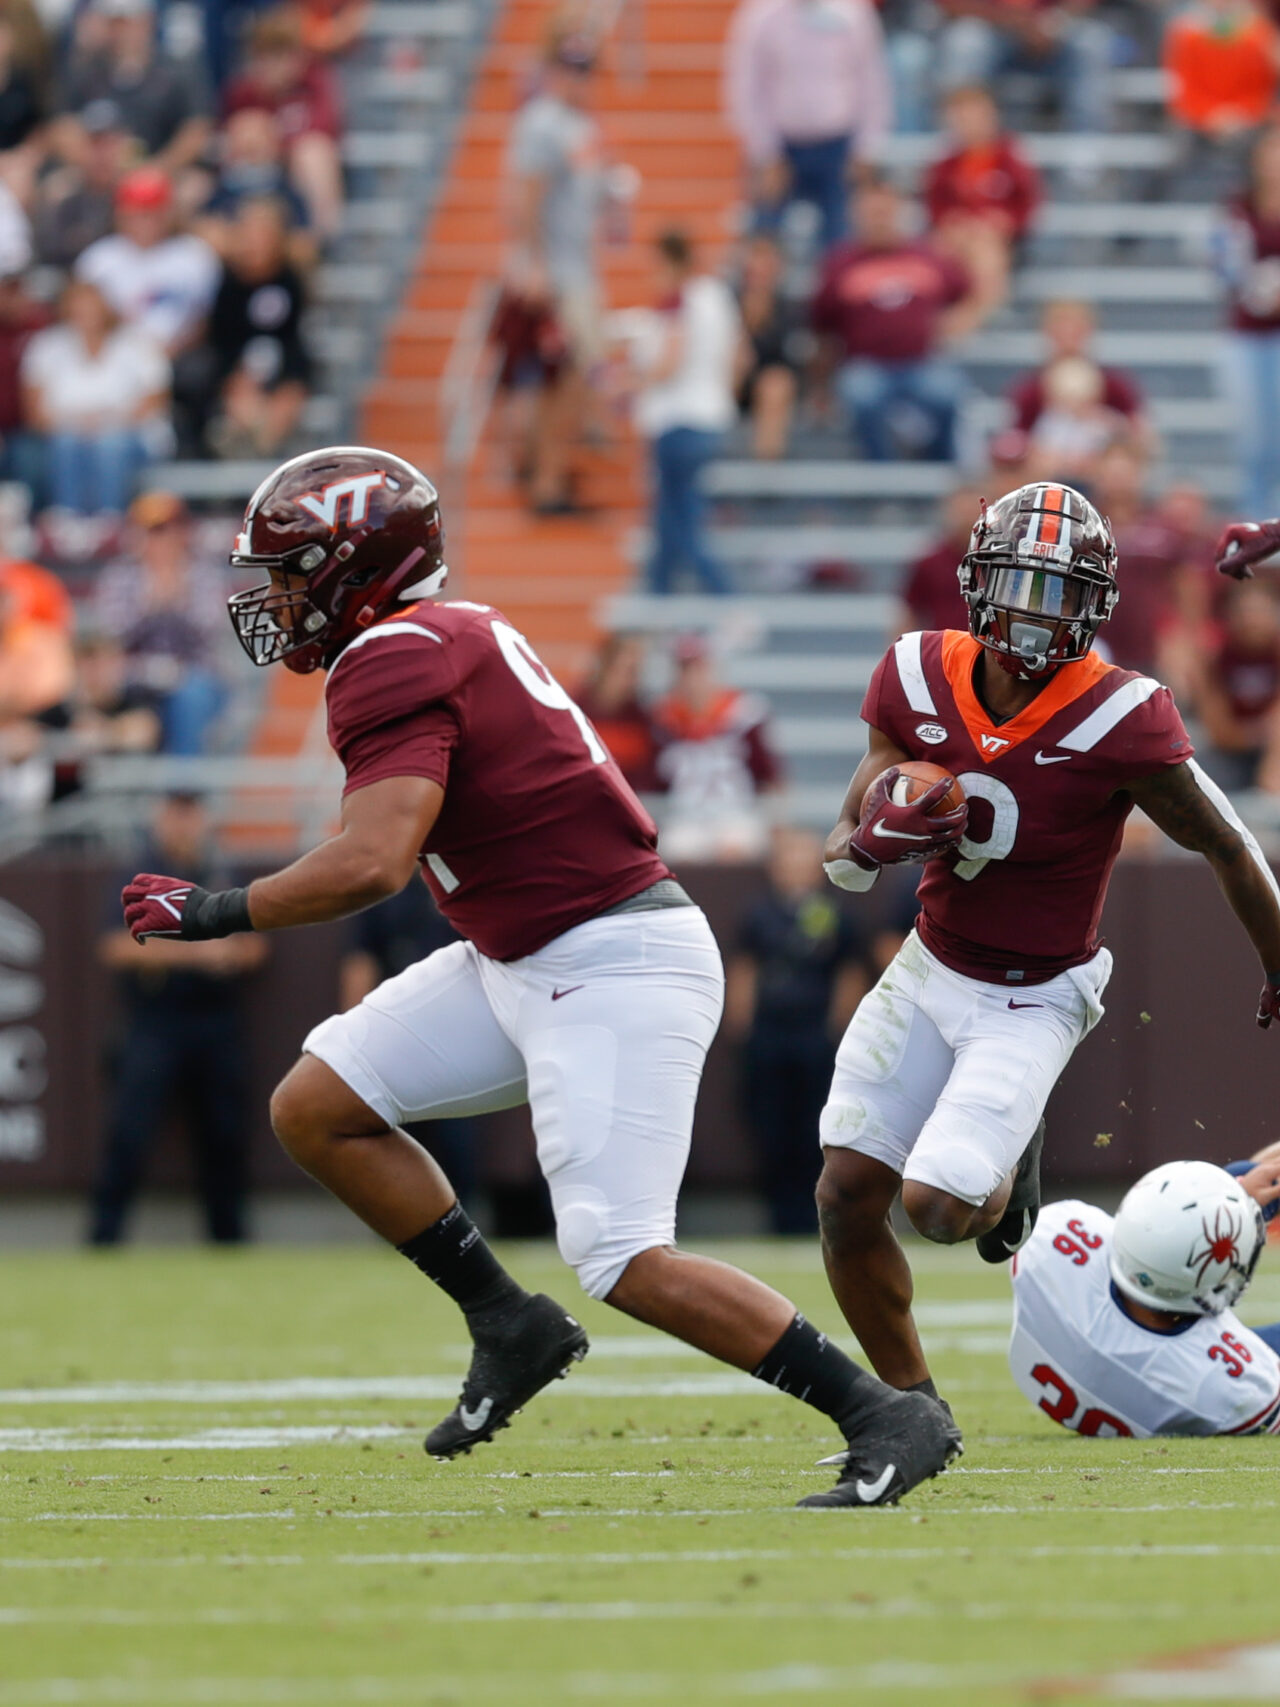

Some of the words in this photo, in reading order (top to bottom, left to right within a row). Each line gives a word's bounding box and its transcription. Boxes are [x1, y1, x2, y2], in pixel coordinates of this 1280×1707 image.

[295, 470, 386, 532] VT
[1033, 542, 1057, 559] GRIT
[920, 727, 944, 739] ACC
[981, 734, 1009, 752] VT
[953, 771, 1019, 881] 9
[1052, 1219, 1103, 1266] 36
[1207, 1331, 1252, 1378] 36
